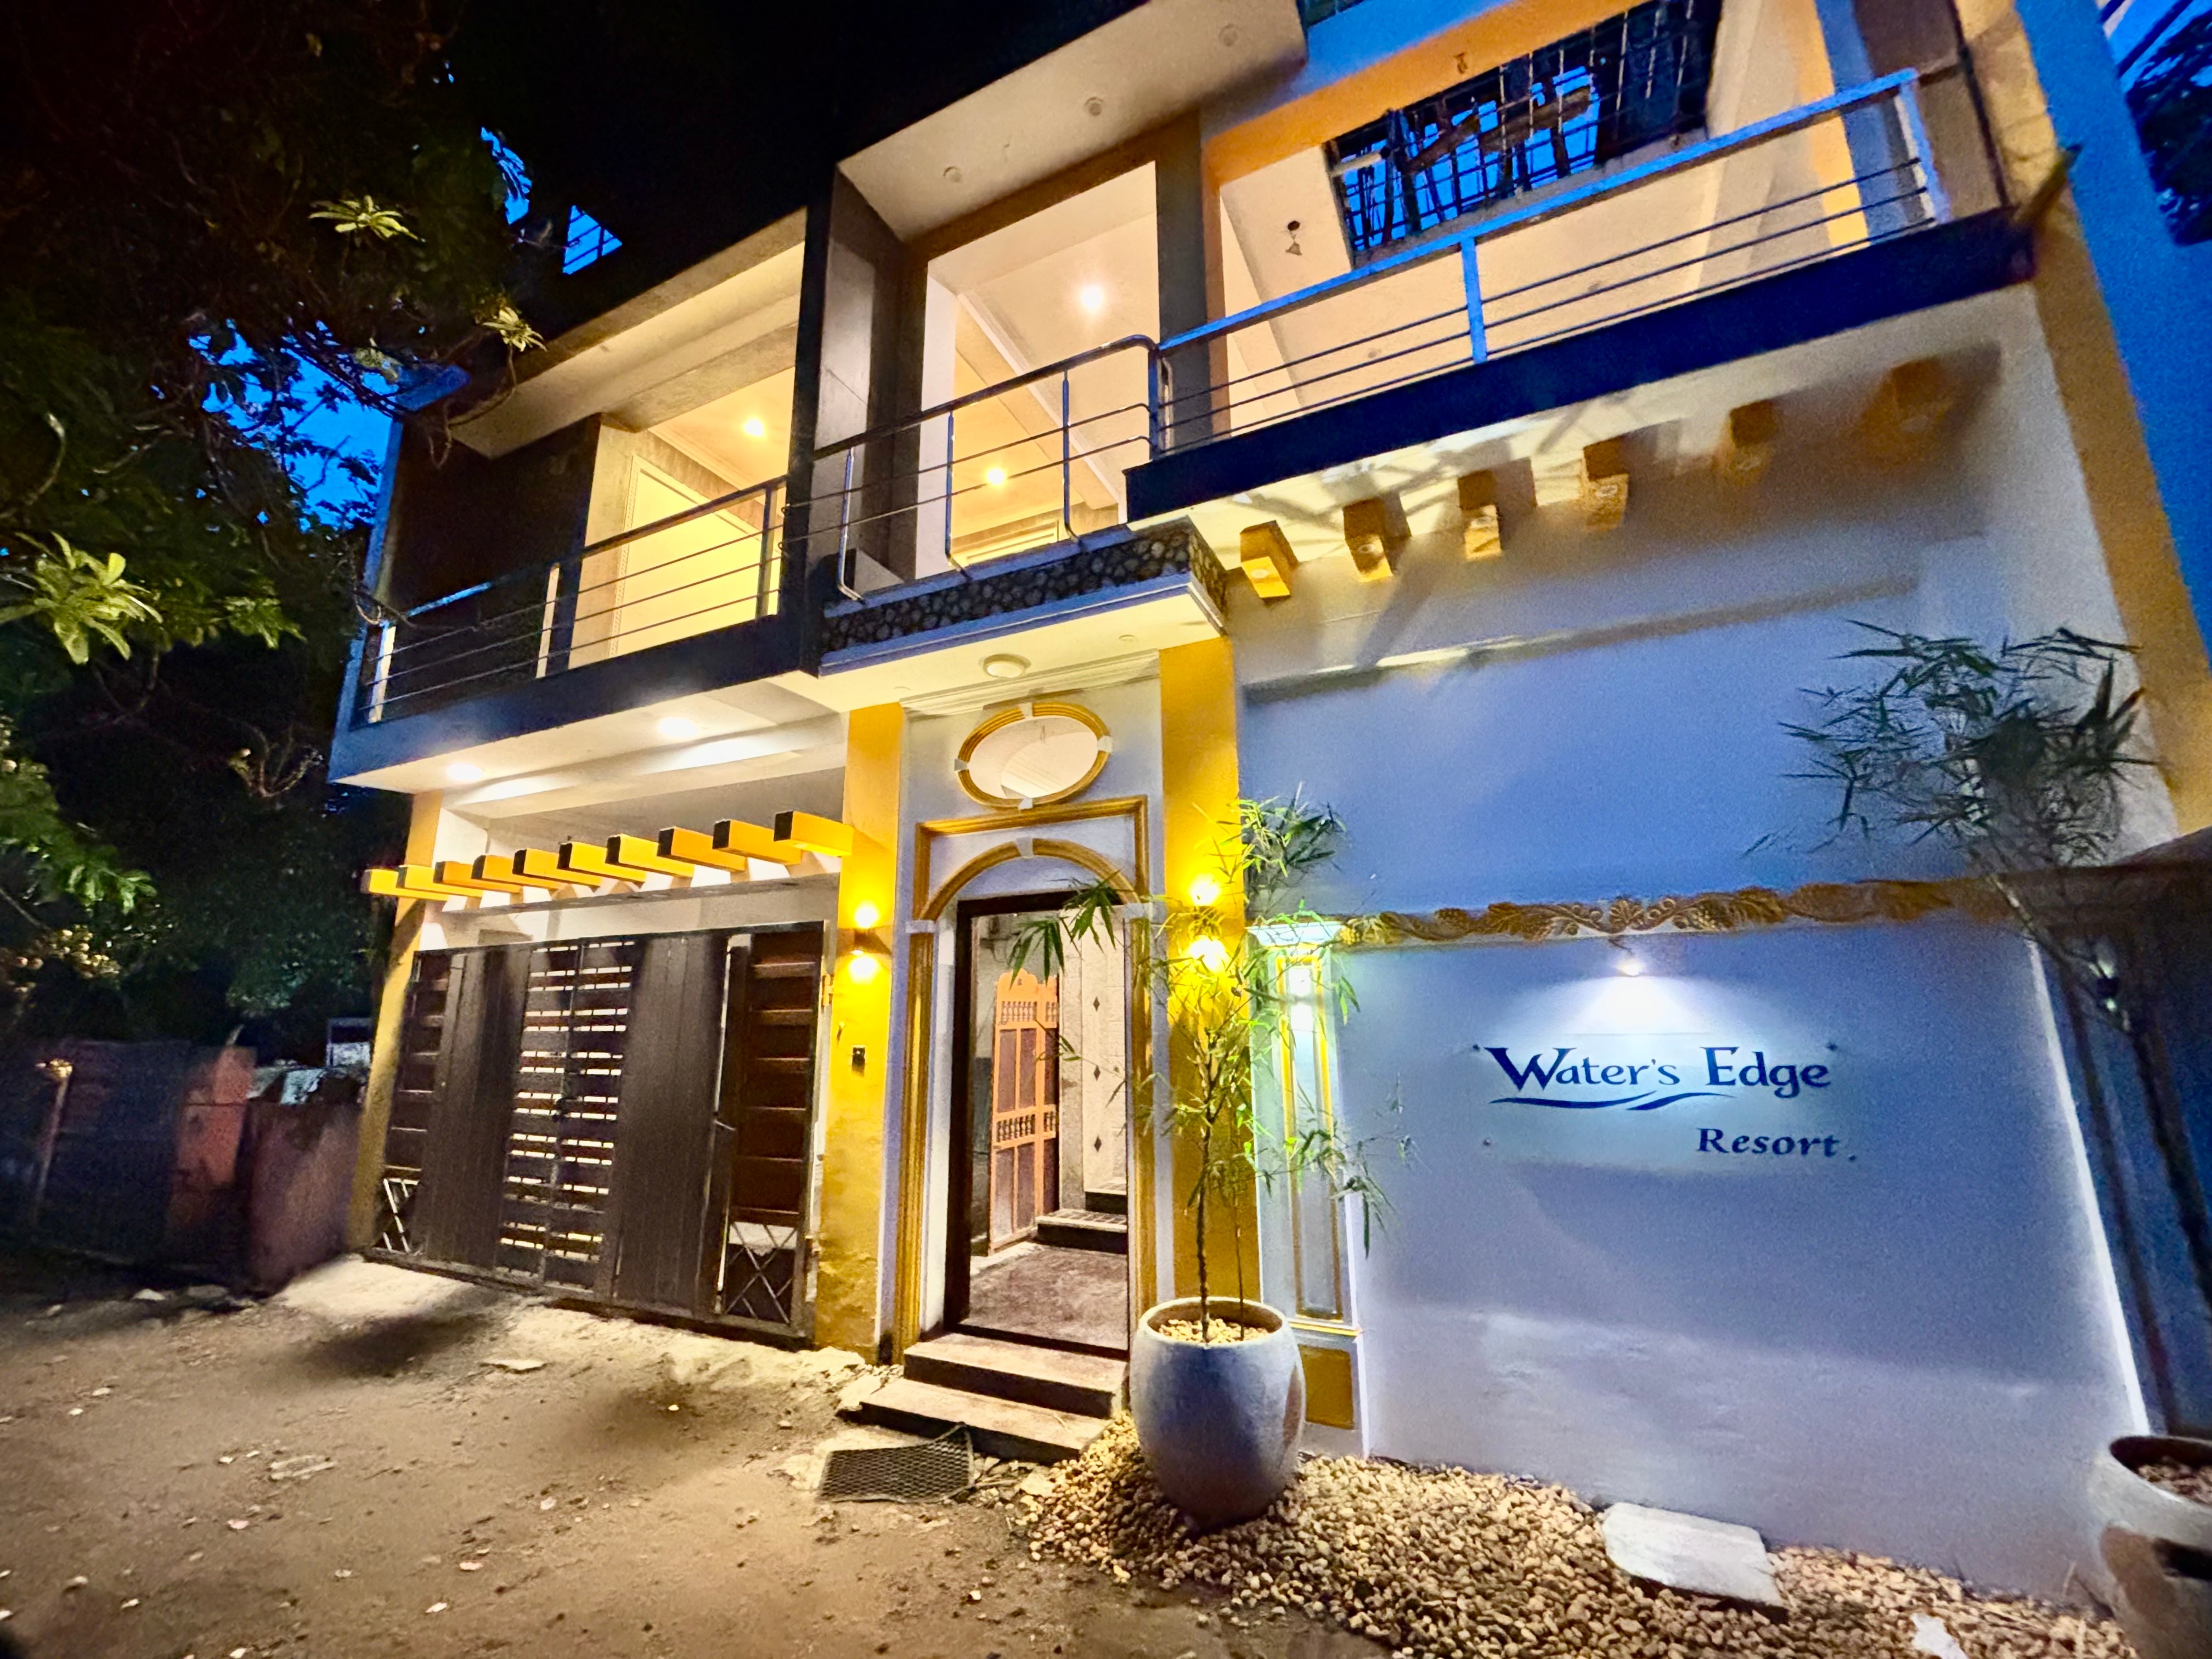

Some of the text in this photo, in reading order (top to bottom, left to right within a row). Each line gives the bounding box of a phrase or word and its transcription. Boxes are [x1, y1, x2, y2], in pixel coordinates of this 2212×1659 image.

[1483, 1046, 1832, 1098] Water's Edge
[1696, 1127, 1840, 1157] Resort
